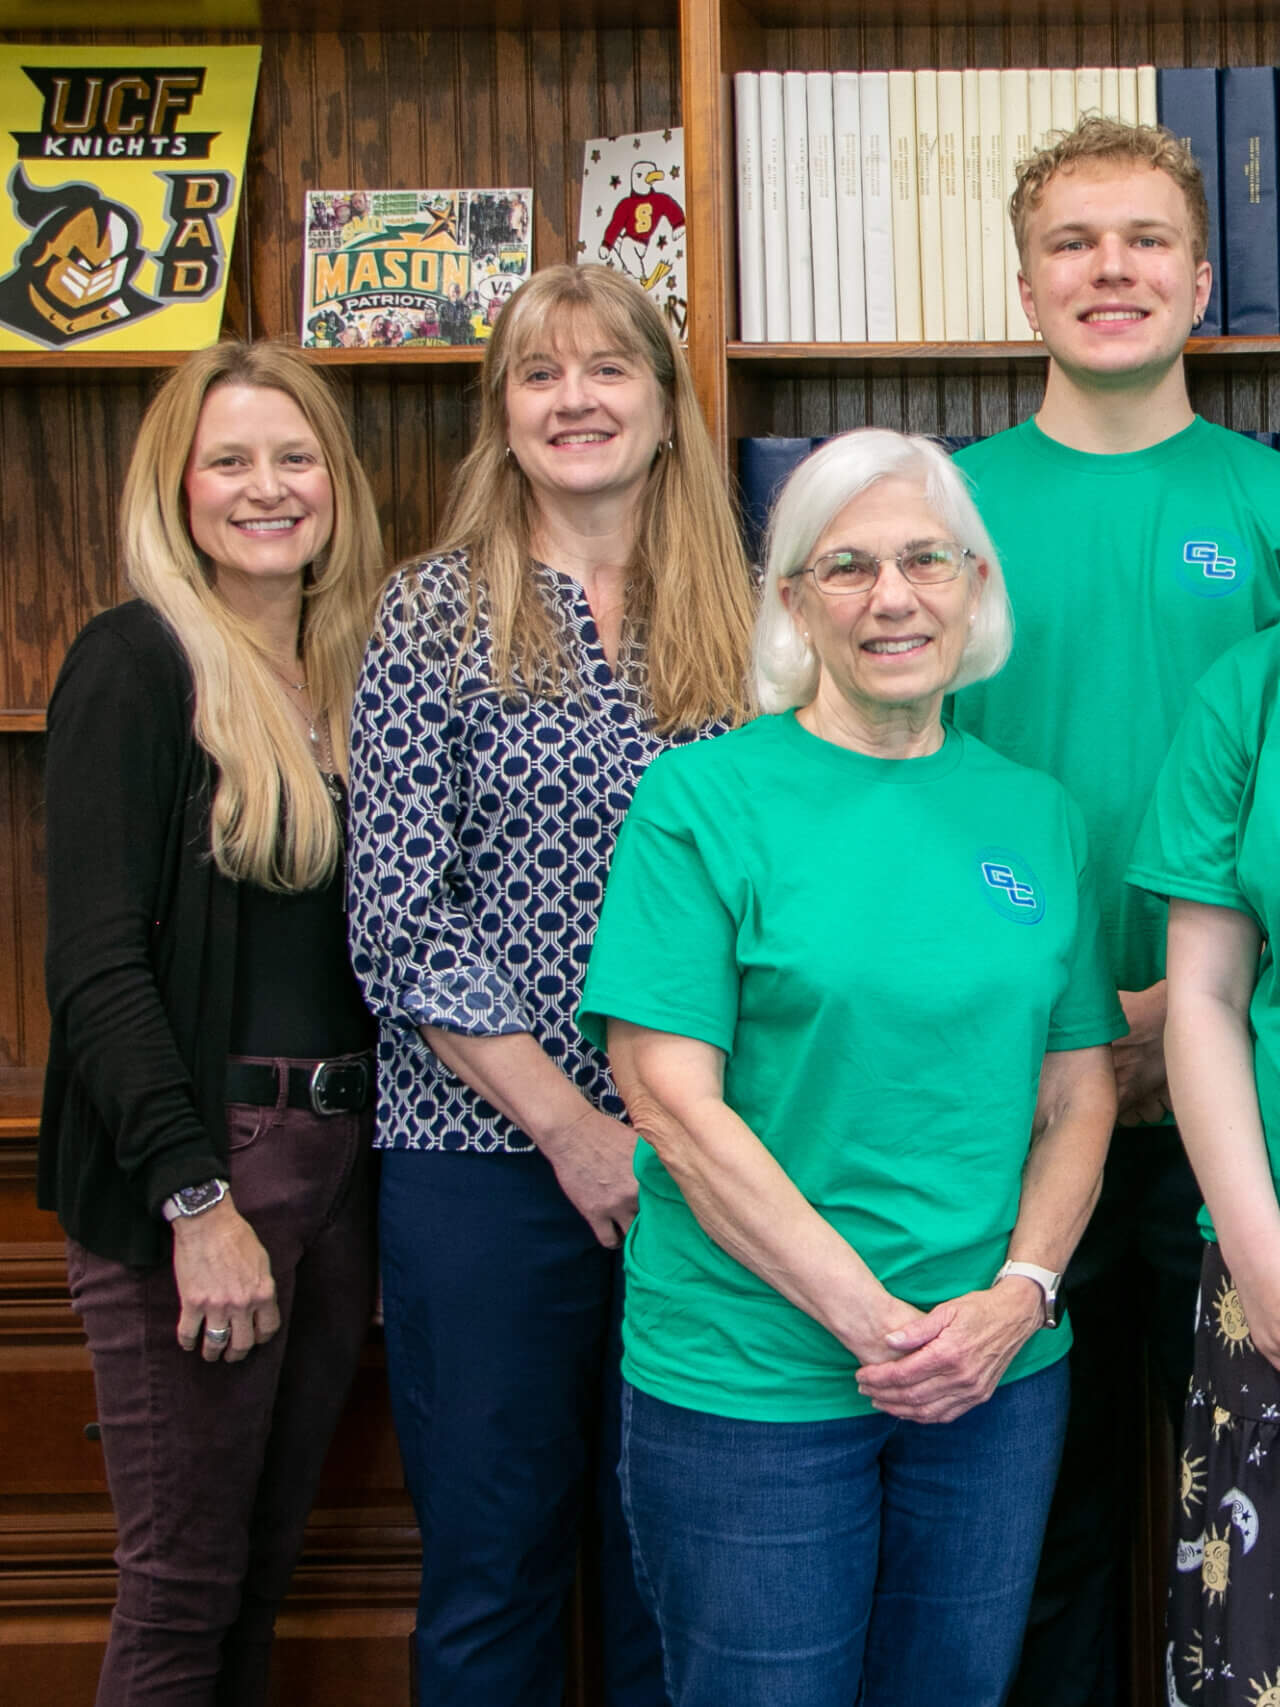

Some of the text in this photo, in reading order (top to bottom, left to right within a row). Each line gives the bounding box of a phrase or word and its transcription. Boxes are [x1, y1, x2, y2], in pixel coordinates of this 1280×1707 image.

[51, 75, 200, 134] UCF
[44, 137, 188, 157] KNIGHTS
[173, 177, 219, 292] DAD
[634, 202, 653, 234] S
[315, 250, 468, 305] MASON
[490, 280, 513, 296] VA
[345, 294, 438, 310] PATRIOTS
[1183, 541, 1236, 580] GC
[981, 862, 1037, 909] GC
